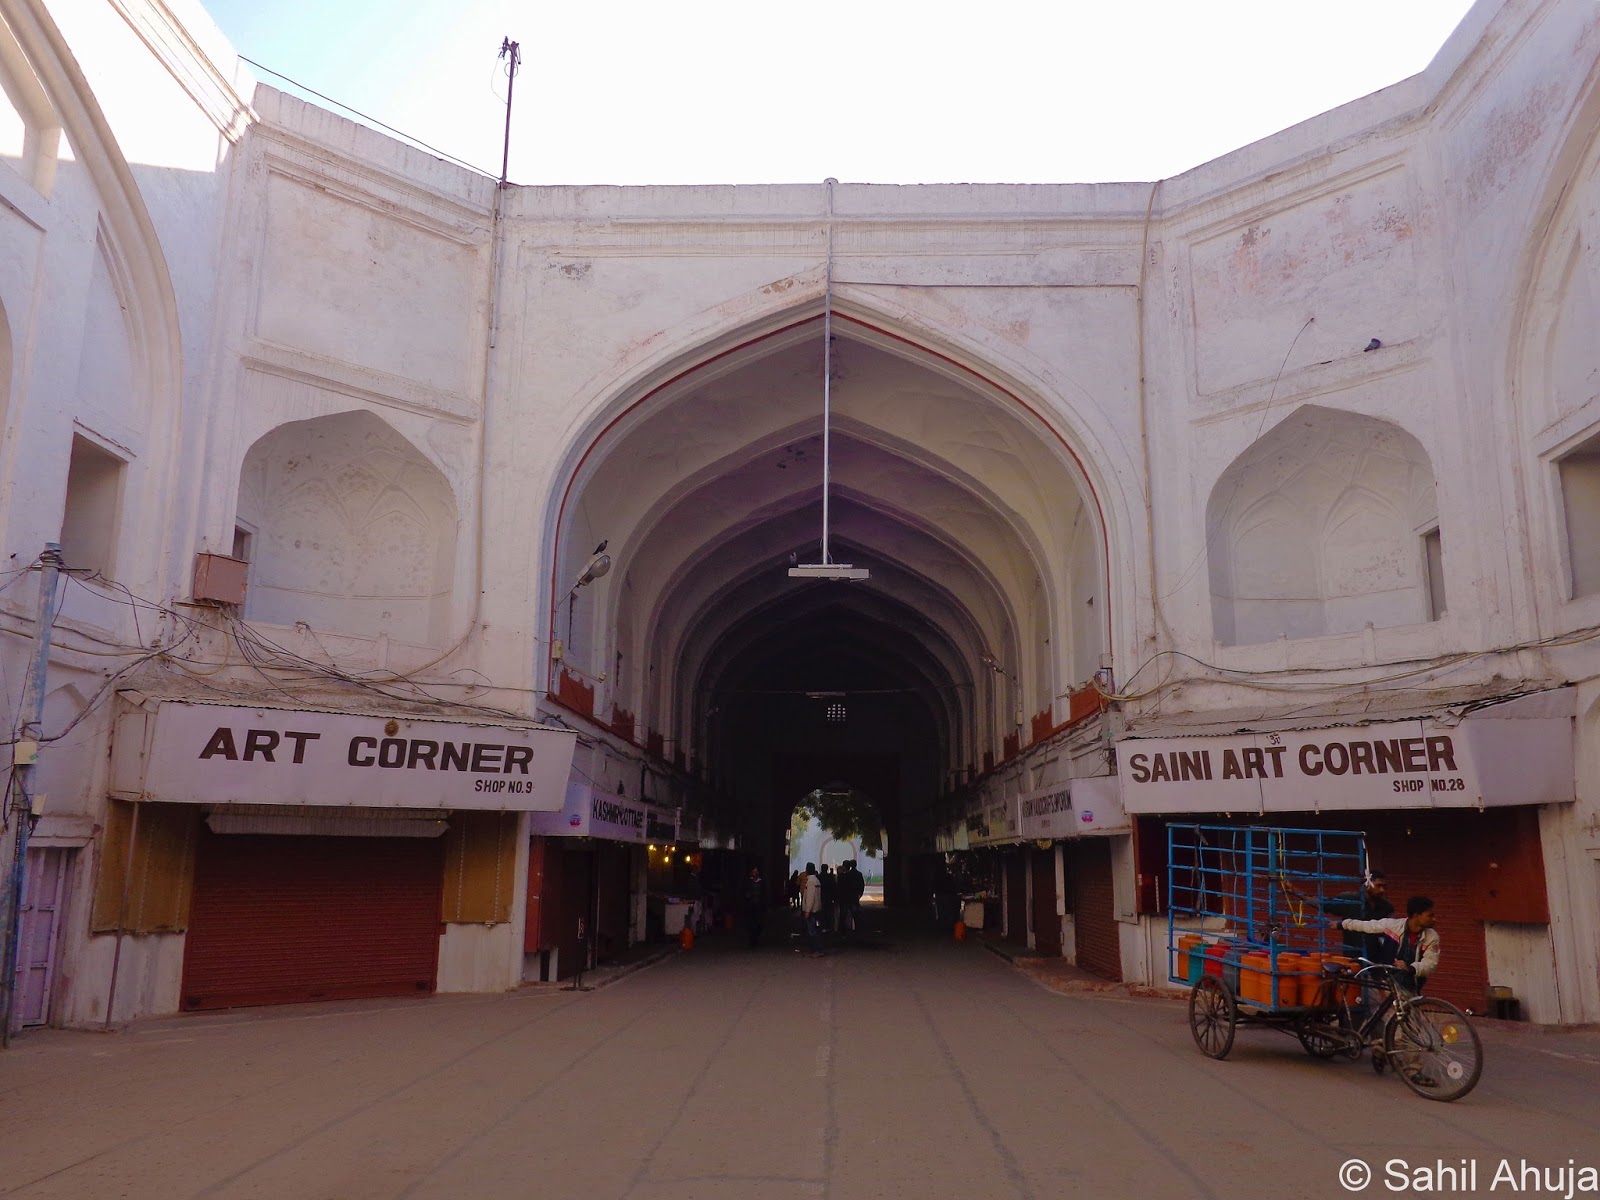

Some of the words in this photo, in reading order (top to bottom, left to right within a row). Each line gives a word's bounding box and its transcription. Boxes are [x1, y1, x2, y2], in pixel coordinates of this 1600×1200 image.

[198, 727, 321, 764] ART
[348, 735, 534, 775] CORNER
[1130, 751, 1213, 783] SAINI
[1222, 746, 1287, 780] ART
[1299, 735, 1458, 777] CORNER
[475, 779, 505, 793] SHOP
[507, 780, 534, 794] NO.9
[1393, 779, 1424, 793] SHOP
[1431, 777, 1466, 792] NO.28
[592, 797, 619, 824] KASHMIR
[620, 807, 644, 829] COTTAGE
